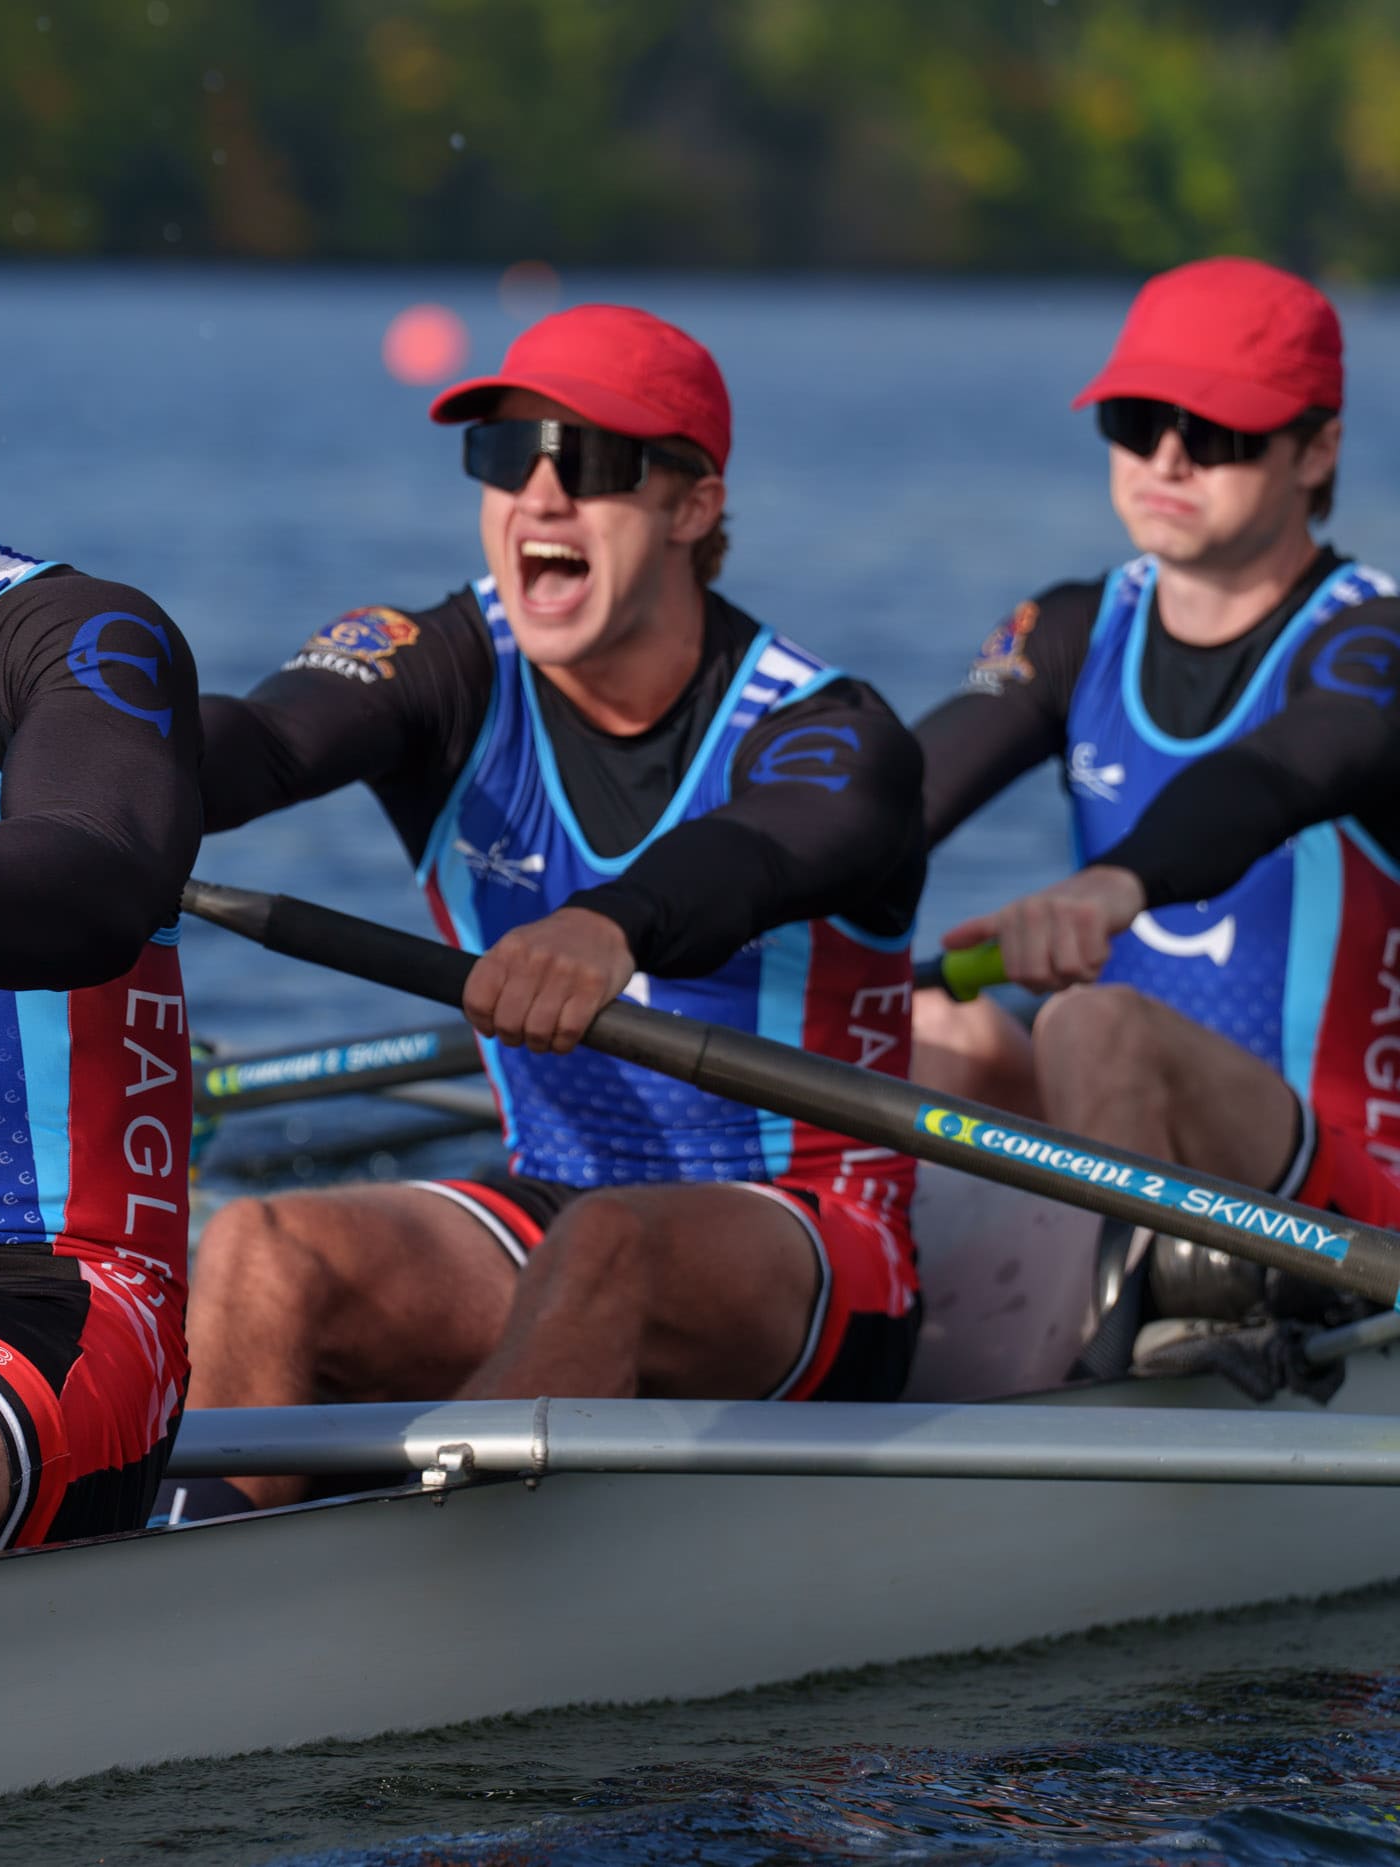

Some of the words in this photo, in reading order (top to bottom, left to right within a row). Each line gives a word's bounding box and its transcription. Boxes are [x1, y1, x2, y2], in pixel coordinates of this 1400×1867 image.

[981, 1128, 1134, 1188] concept
[1139, 1175, 1166, 1198] 2
[1180, 1187, 1341, 1252] SKINNY
